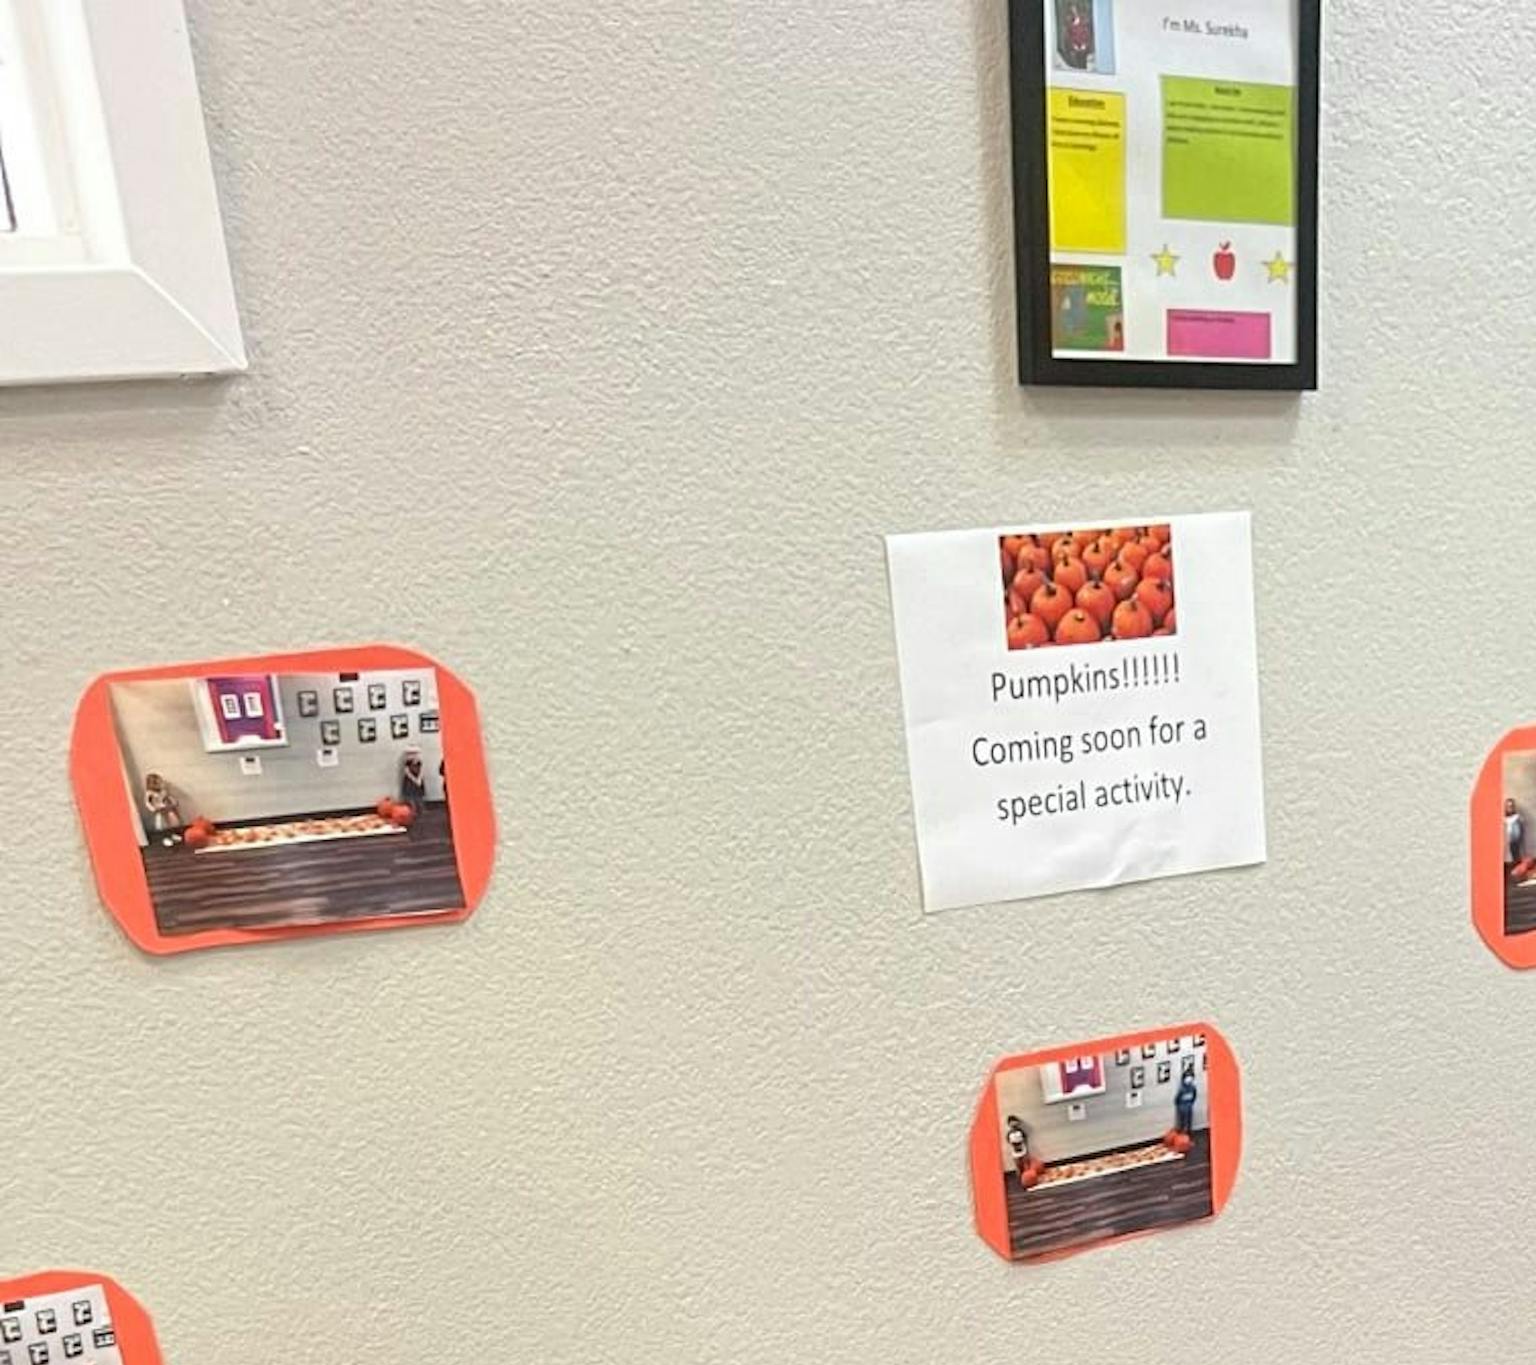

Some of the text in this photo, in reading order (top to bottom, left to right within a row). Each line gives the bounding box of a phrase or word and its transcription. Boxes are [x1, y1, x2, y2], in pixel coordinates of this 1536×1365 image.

[991, 653, 1180, 704] Pumpkins!!!!!!
[972, 715, 1208, 767] Coming soon for a
[997, 771, 1192, 826] special activity.
